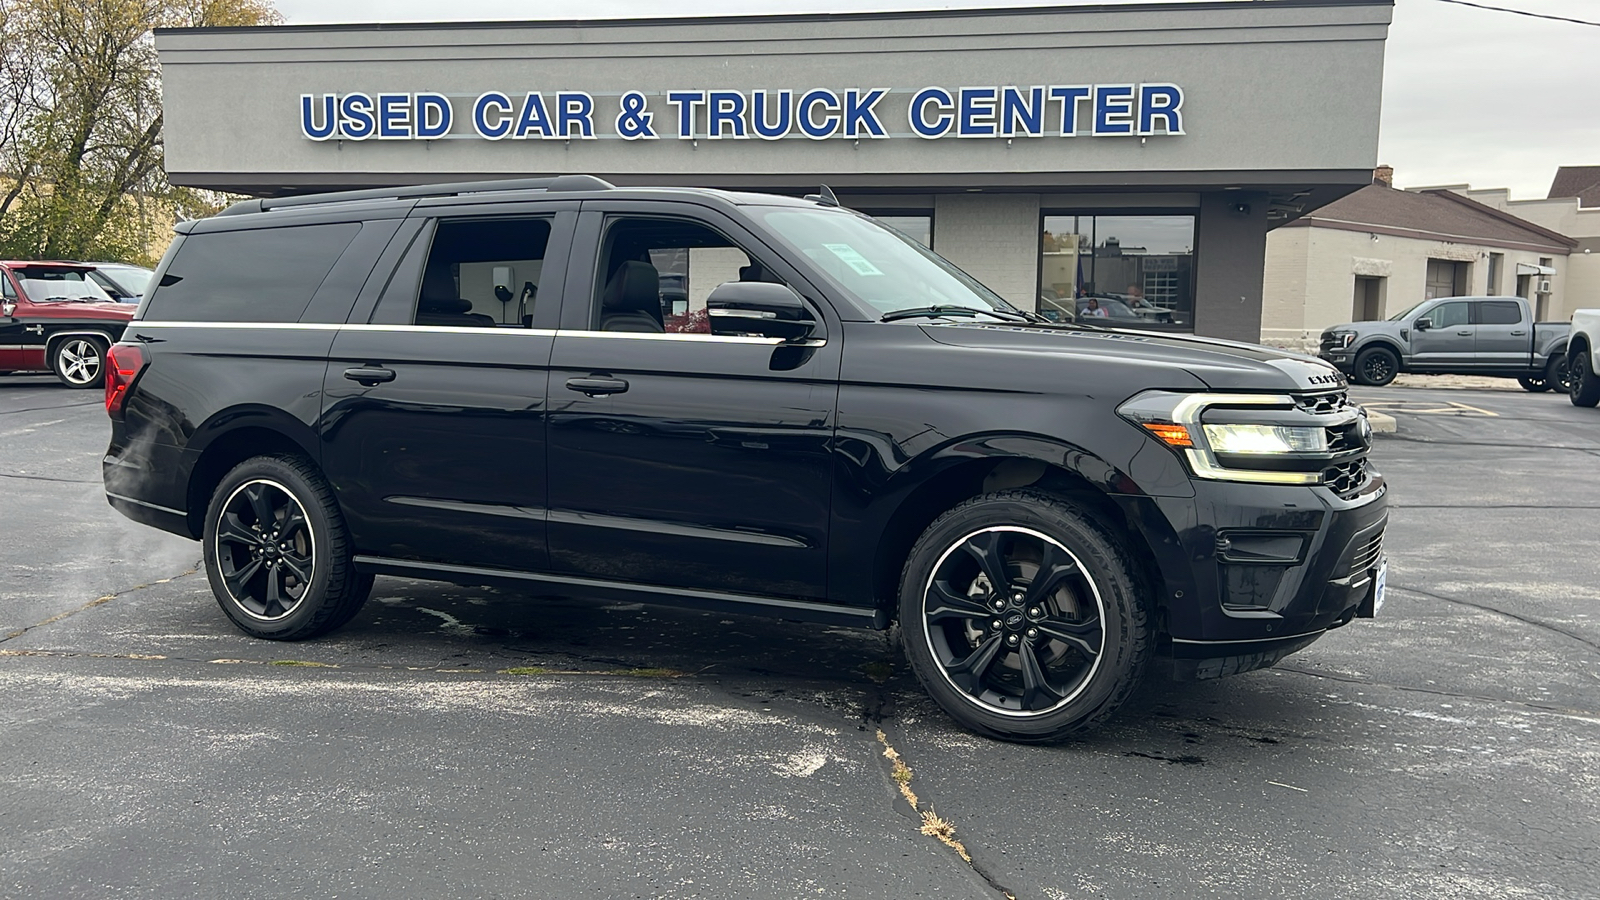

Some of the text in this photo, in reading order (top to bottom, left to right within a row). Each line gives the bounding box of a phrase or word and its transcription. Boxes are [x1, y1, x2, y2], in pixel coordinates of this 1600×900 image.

[300, 82, 1187, 141] USED CAR & TRUCK CENTER
